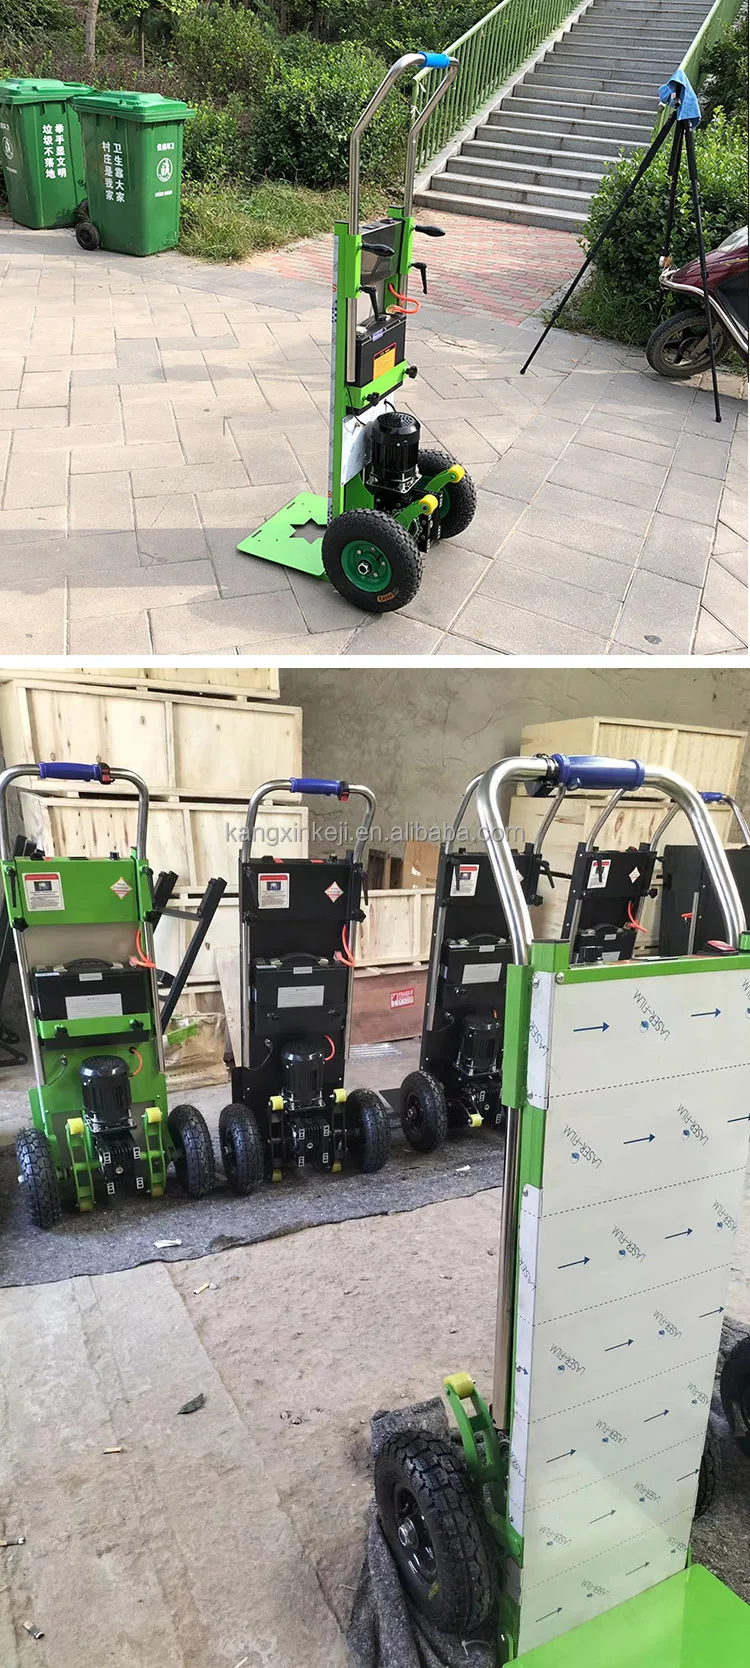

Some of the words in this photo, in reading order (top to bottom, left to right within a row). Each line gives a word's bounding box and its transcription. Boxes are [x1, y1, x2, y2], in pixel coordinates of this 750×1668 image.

[42, 124, 56, 179] 垃圾不落地
[102, 141, 114, 201] 村庄是我家
[113, 143, 126, 203] 卫生靠大家
